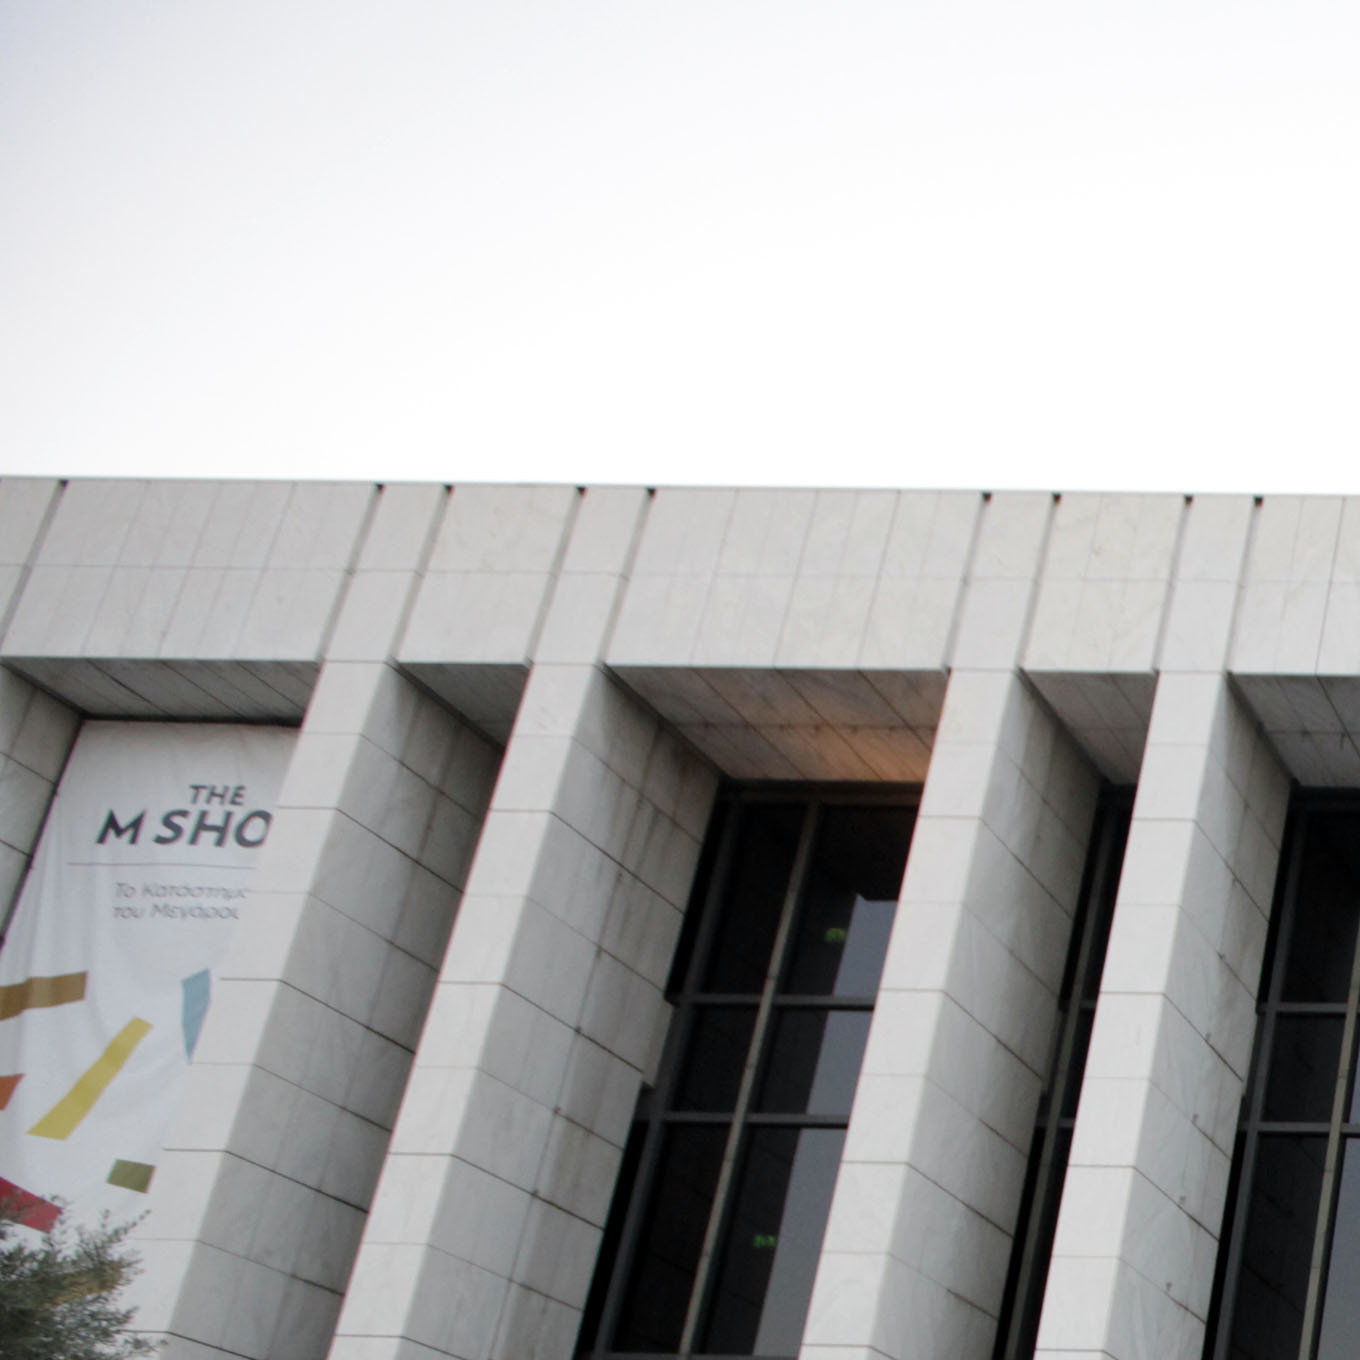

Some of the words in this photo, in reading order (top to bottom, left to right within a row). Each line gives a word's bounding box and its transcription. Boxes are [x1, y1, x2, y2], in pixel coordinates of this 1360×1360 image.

[189, 784, 246, 806] THE
[96, 808, 147, 846] M
[153, 808, 273, 848] SHO
